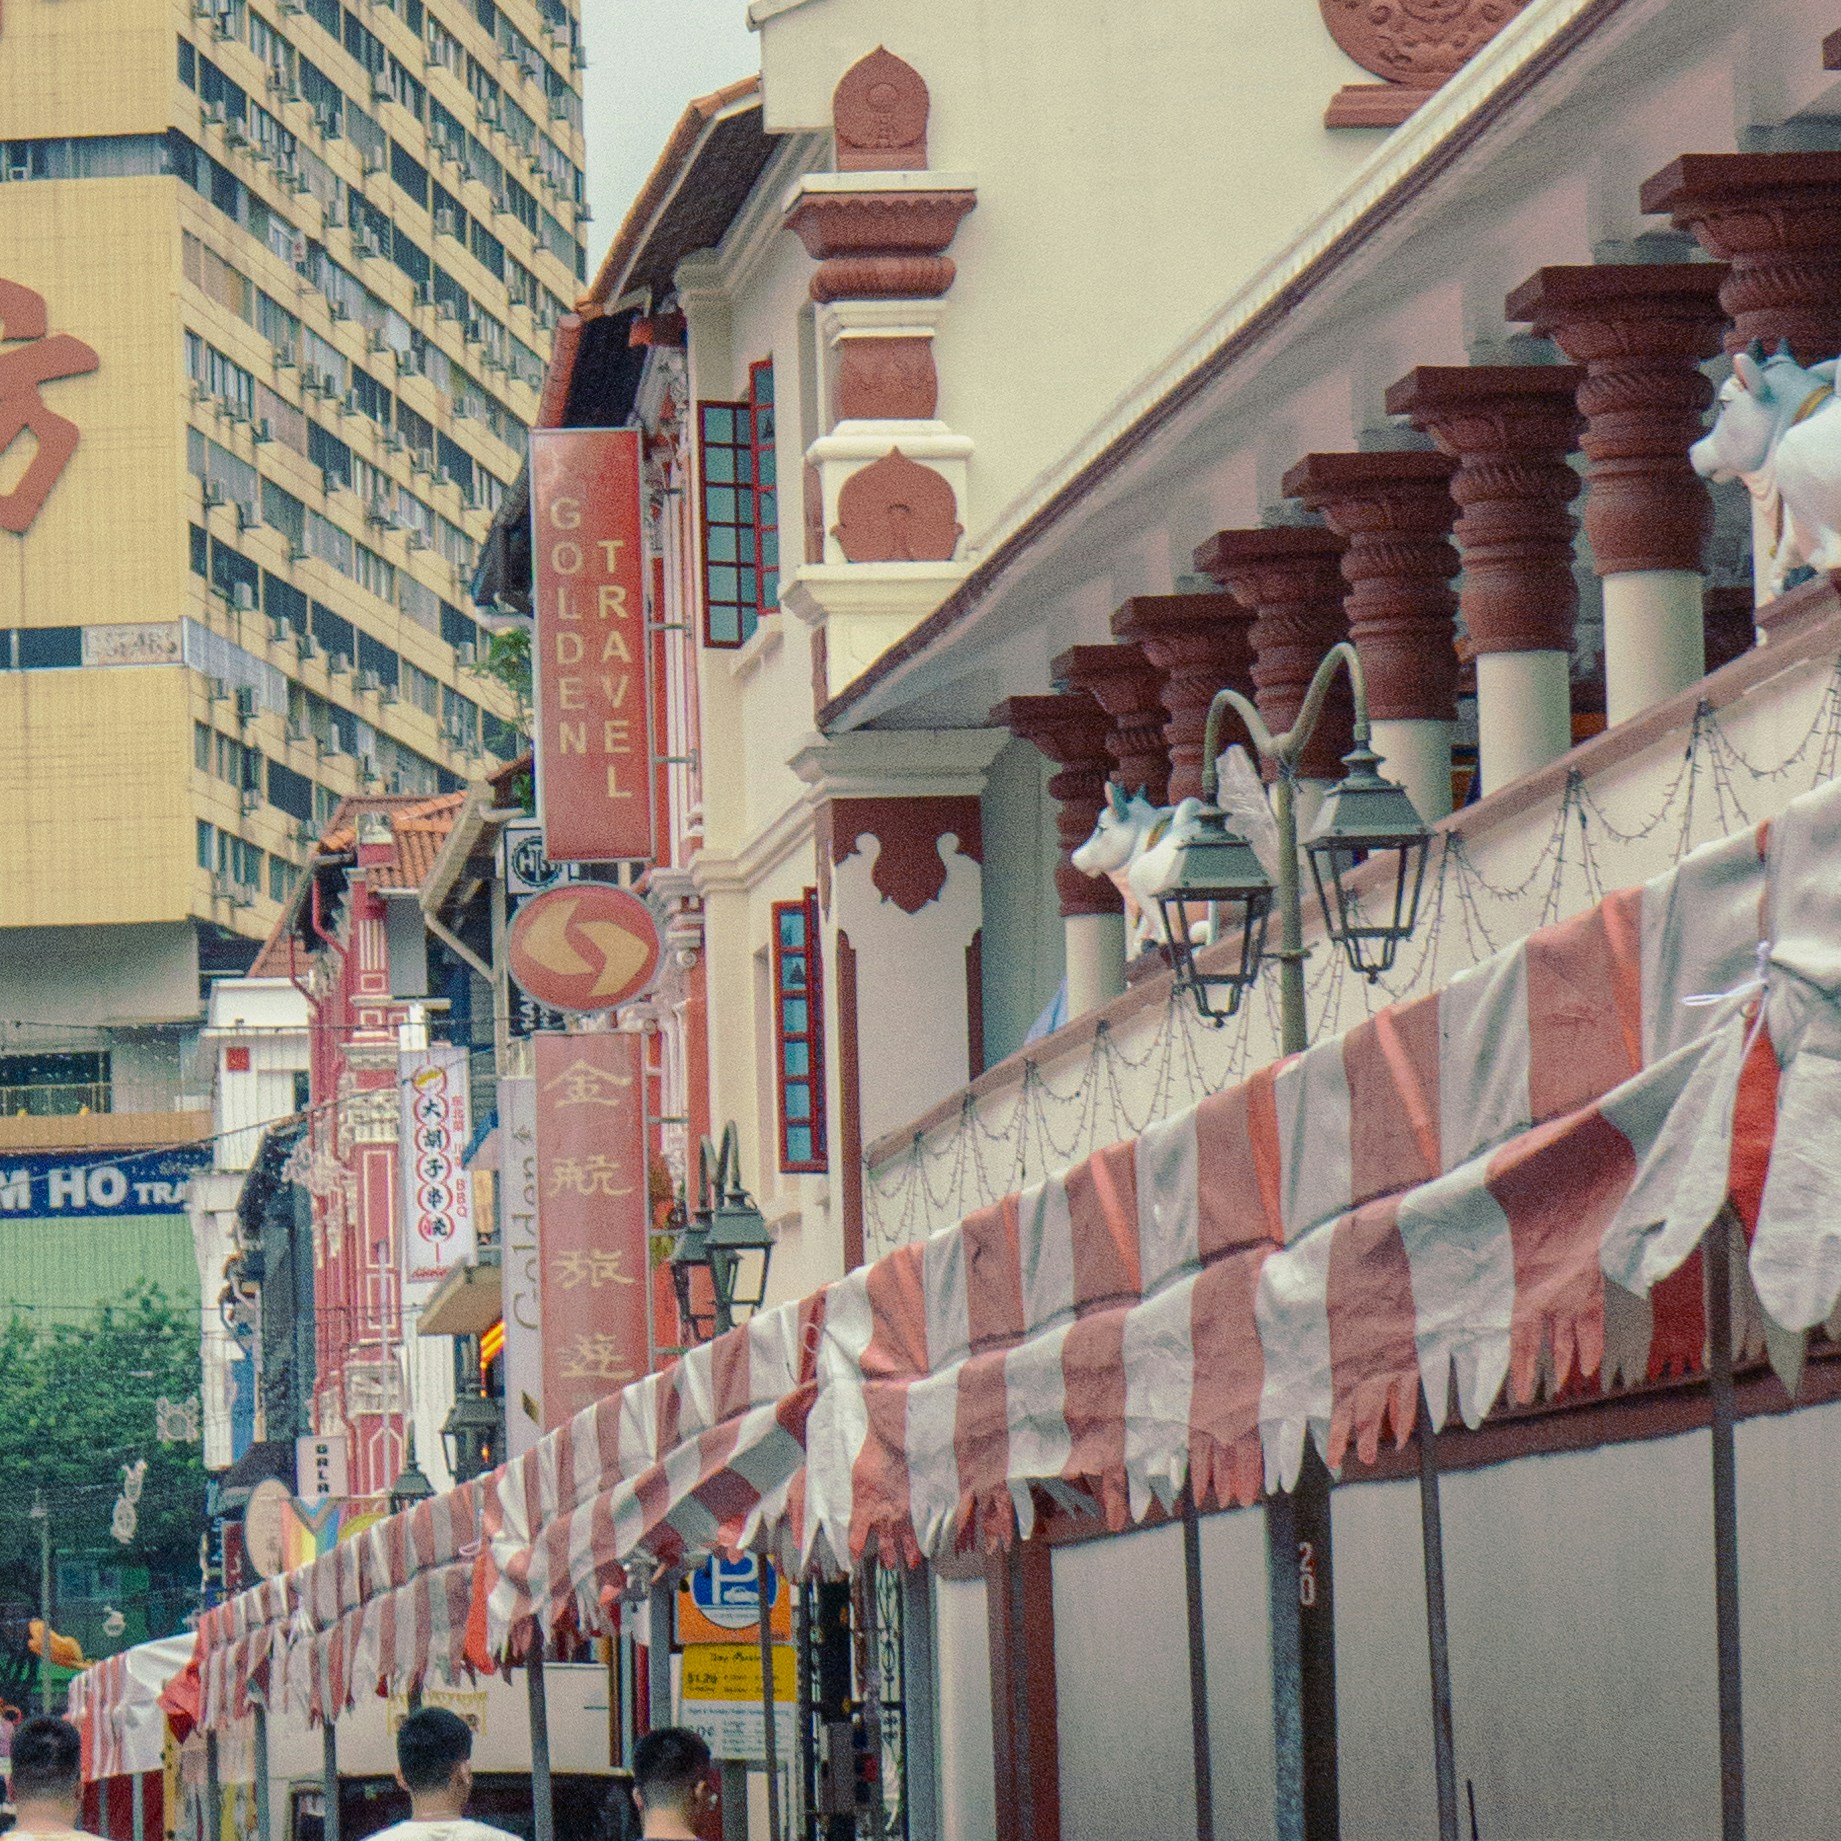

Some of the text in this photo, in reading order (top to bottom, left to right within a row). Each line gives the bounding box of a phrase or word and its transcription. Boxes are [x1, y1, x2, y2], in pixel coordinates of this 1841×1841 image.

[549, 497, 587, 755] GOLDEN
[596, 539, 633, 800] TRAVEL
[49, 1166, 127, 1209] HO
[456, 1178, 467, 1217] BBQ
